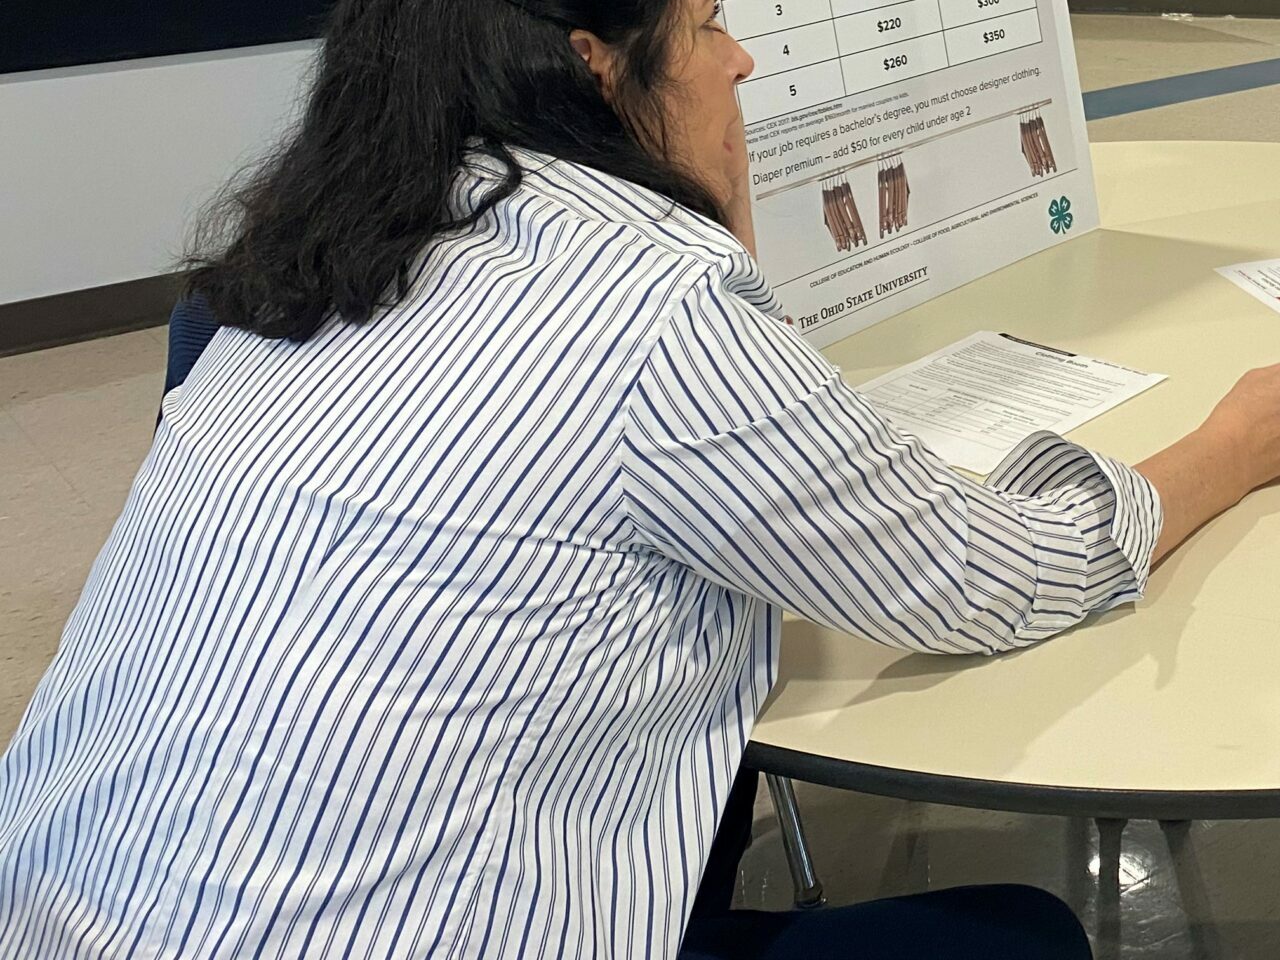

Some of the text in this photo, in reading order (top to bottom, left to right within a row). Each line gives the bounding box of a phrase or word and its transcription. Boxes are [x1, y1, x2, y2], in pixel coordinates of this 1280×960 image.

[775, 4, 783, 16] 3
[877, 17, 902, 32] $220
[983, 28, 1006, 43] $350
[782, 44, 790, 56] 4
[883, 54, 908, 70] $260
[790, 84, 797, 96] 5
[750, 66, 1042, 162] If your job requires a bachelor's degree, you must choose designer clothing.
[753, 168, 783, 185] Diaper
[785, 154, 824, 176] premium
[833, 144, 848, 159] add
[850, 140, 868, 154] $50
[869, 136, 880, 146] for
[883, 128, 904, 142] every
[906, 118, 924, 134] child
[926, 114, 948, 129] under
[950, 109, 964, 122] age
[966, 106, 972, 116] 2
[810, 276, 830, 288] COLLEGE
[830, 272, 837, 280] OF
[838, 262, 863, 276] EDUCATION
[864, 258, 872, 266] AND
[874, 252, 890, 262] HUMAN
[890, 244, 910, 256] ECOLOGY
[913, 234, 932, 246] COLLEGE
[1021, 192, 1038, 204] SCIENCES
[798, 266, 928, 329] THE OHIO STATE UNIVERSITY
